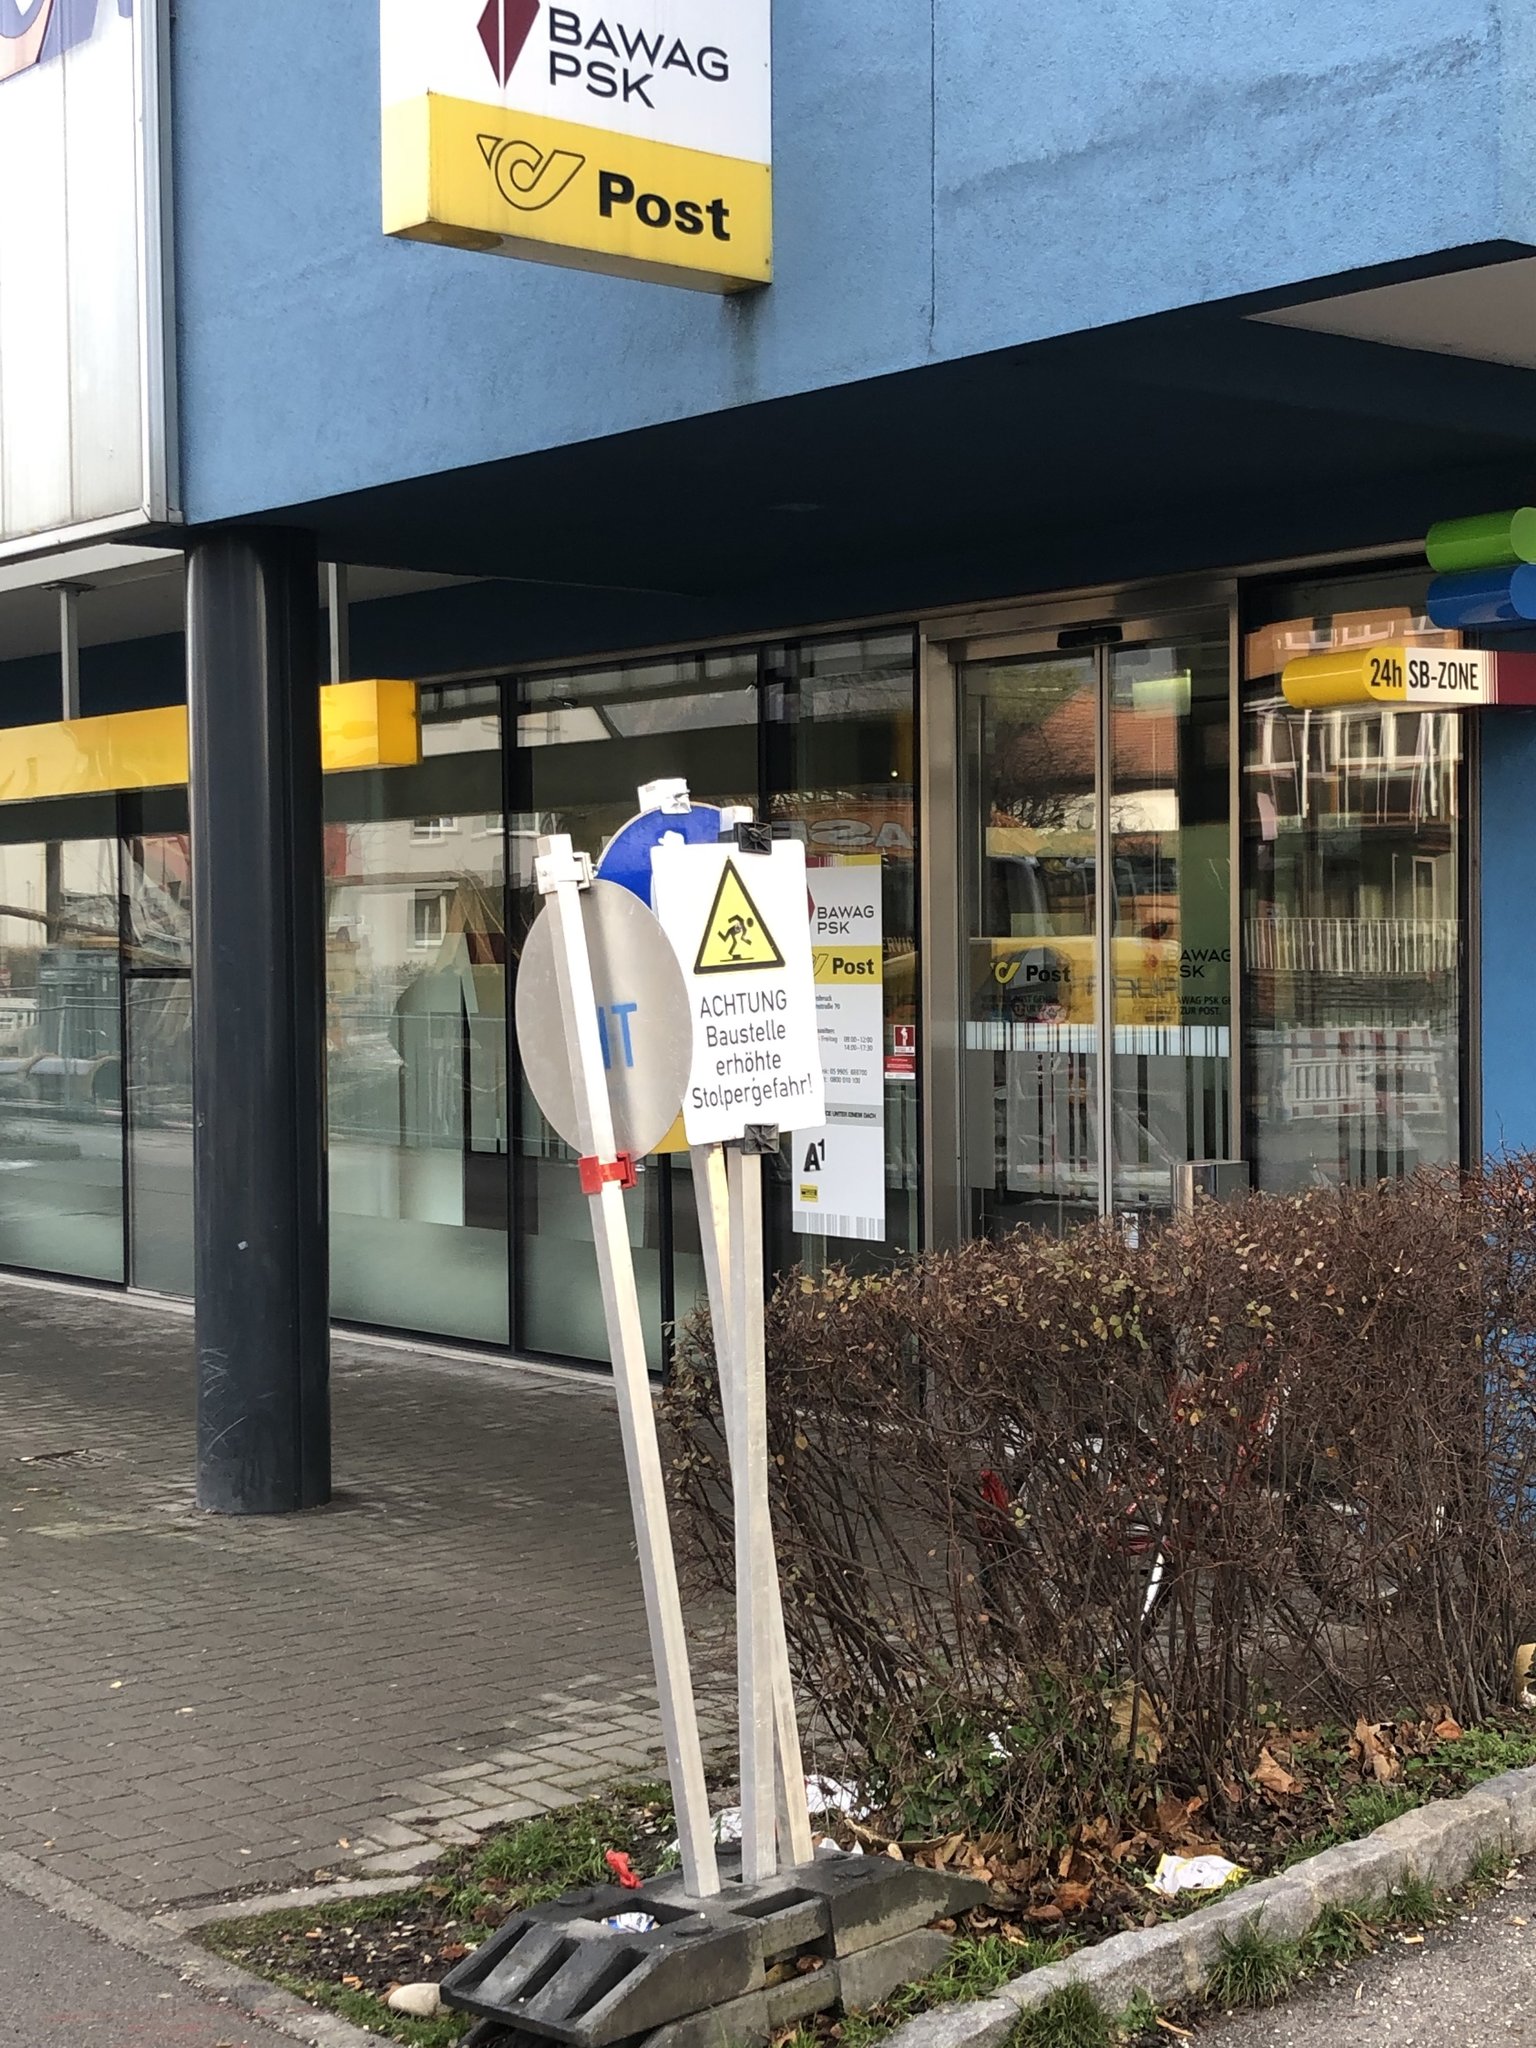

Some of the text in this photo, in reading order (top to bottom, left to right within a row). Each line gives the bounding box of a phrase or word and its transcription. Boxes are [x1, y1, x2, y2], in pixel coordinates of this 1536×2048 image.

[549, 6, 729, 82] BAWAG
[549, 50, 656, 109] PSK
[598, 169, 731, 242] Post
[1370, 657, 1479, 690] 24h SB-ZONE
[817, 904, 875, 919] BAWAG
[817, 921, 850, 935] PSK
[832, 957, 875, 975] Post
[1026, 964, 1071, 983] Post
[700, 989, 788, 1018] ACHTUNG
[706, 1019, 786, 1048] Baustelle
[716, 1051, 782, 1077] erhöhte
[691, 1072, 814, 1111] Stolpergefahr!
